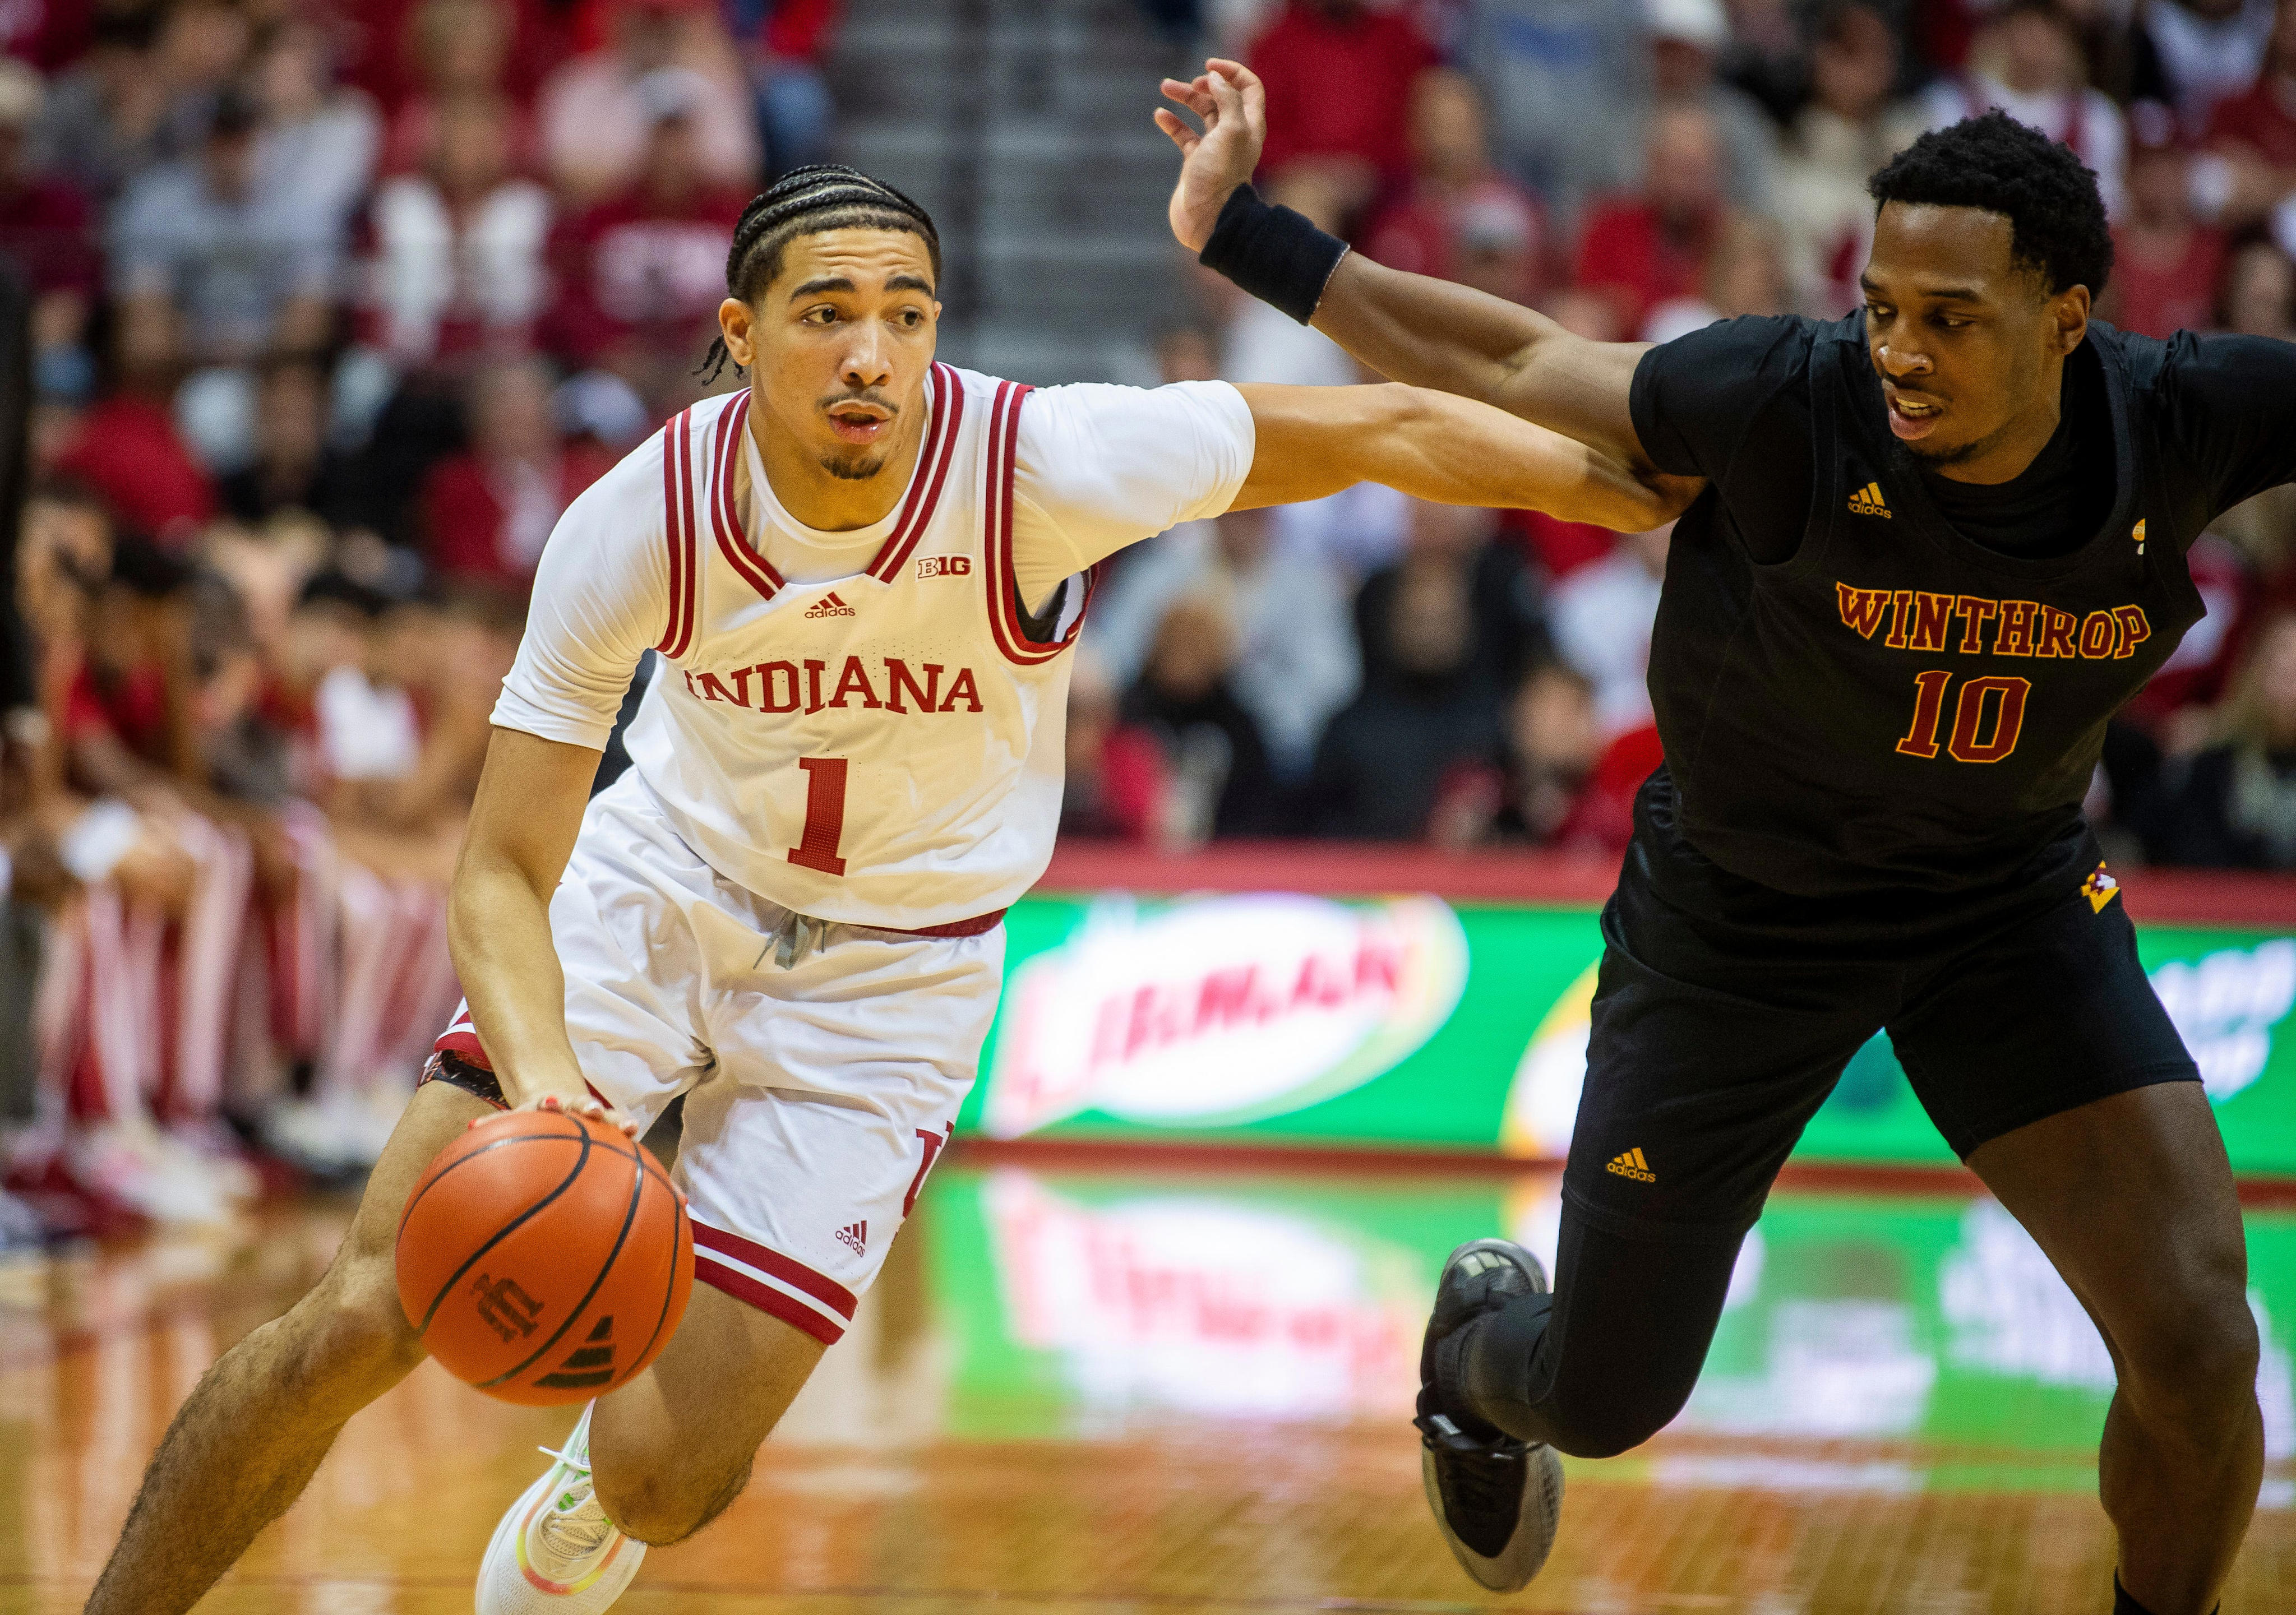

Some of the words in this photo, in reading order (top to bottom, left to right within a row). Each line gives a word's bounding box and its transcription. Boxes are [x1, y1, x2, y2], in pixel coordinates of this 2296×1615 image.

[805, 607, 856, 618] adidas
[1836, 581, 2151, 659] WINTHROP
[1896, 670, 2032, 762] 10
[787, 757, 848, 877] 1
[1606, 1163, 1656, 1183] adidas
[835, 1230, 866, 1258] adidas
